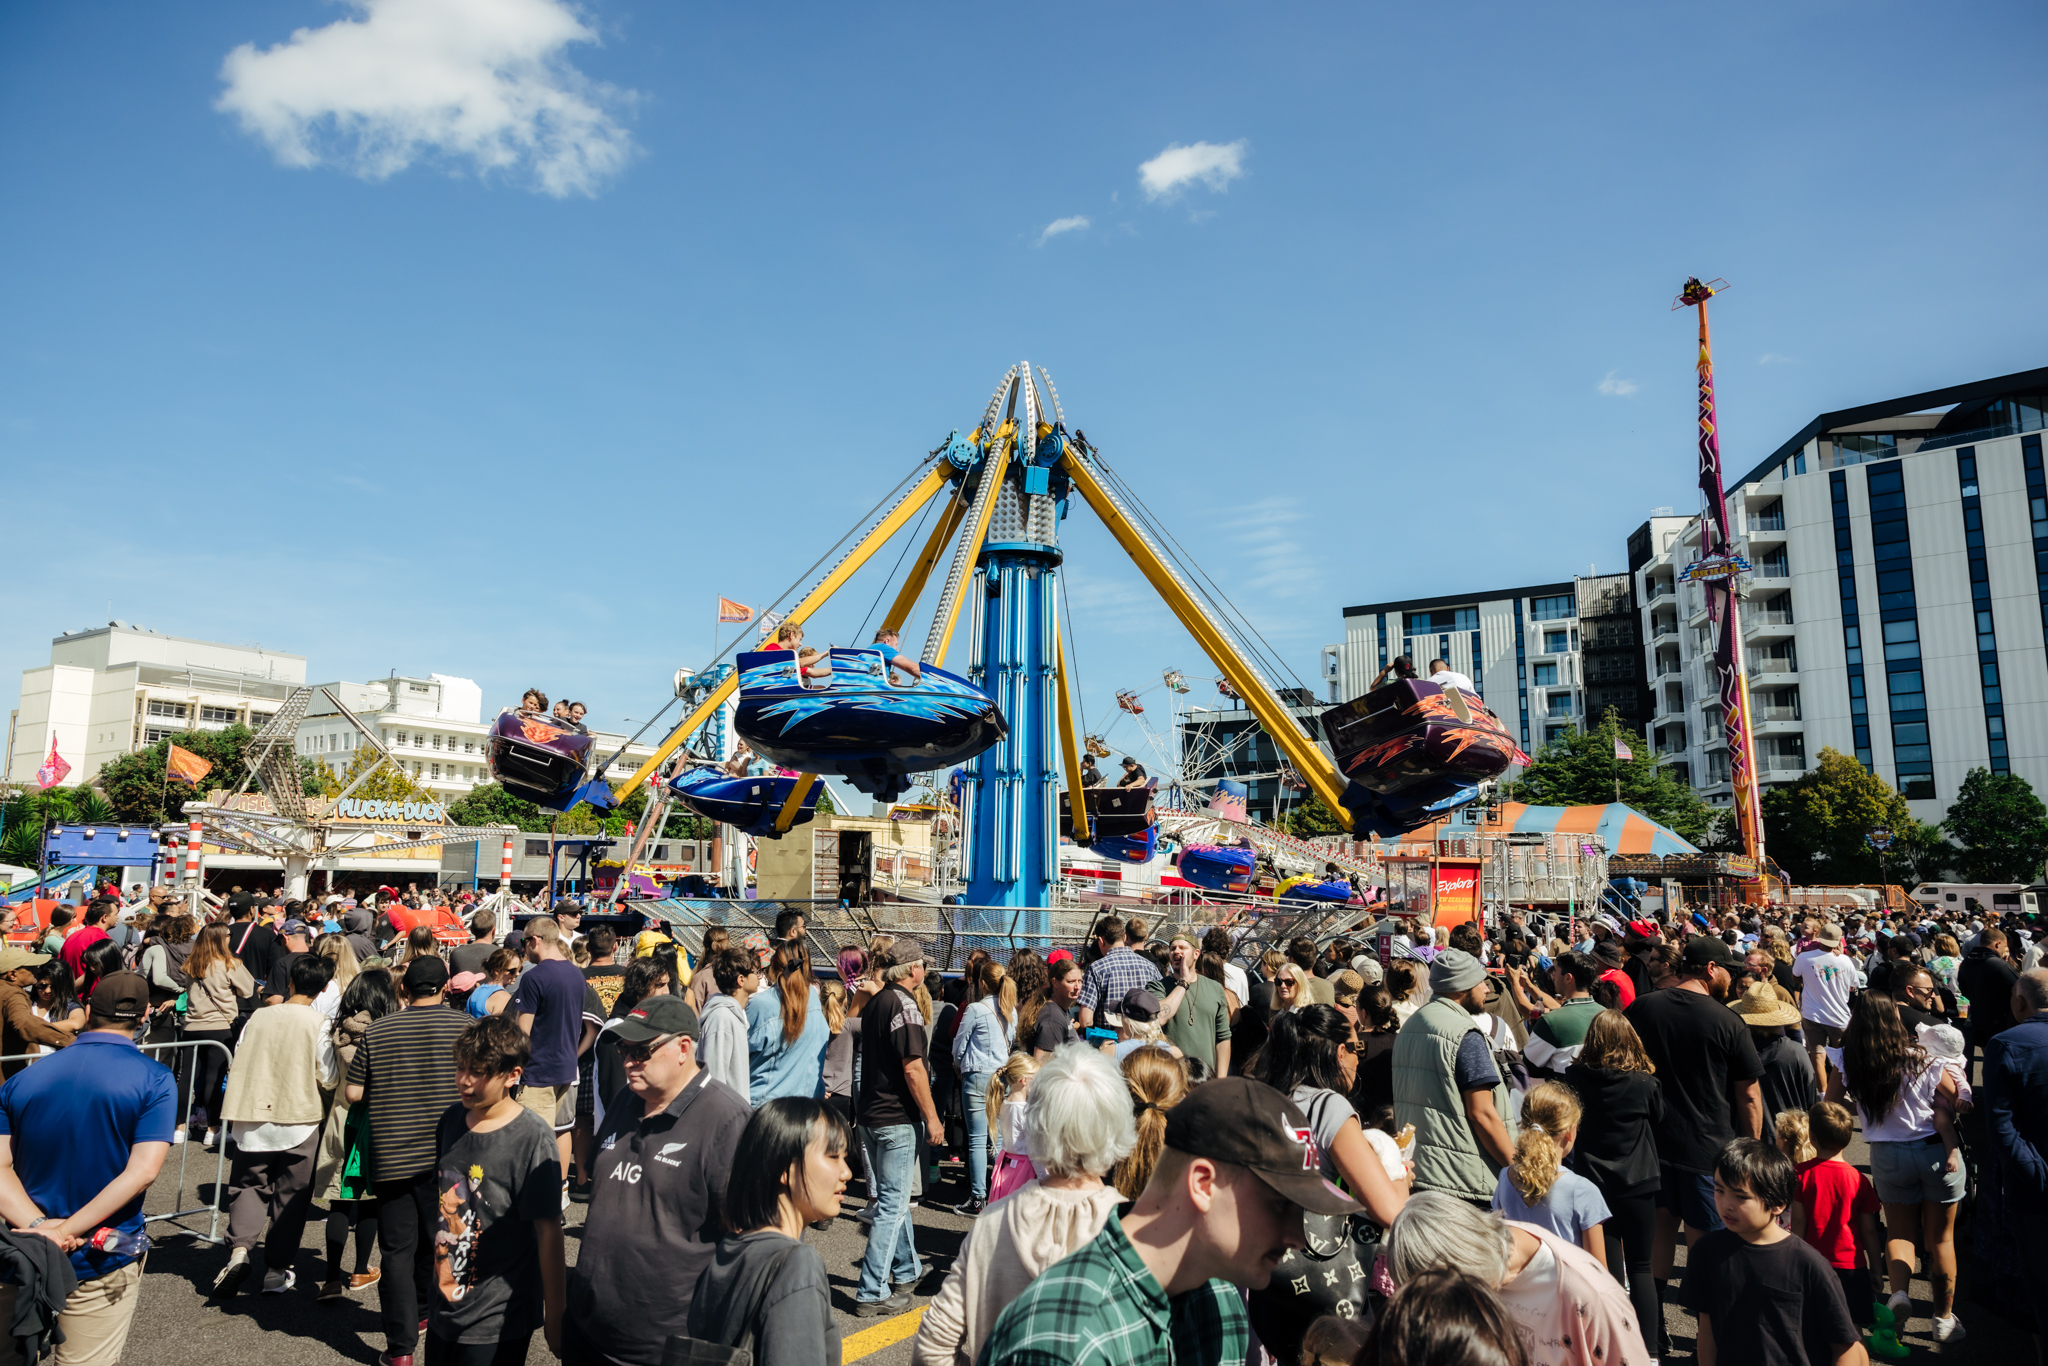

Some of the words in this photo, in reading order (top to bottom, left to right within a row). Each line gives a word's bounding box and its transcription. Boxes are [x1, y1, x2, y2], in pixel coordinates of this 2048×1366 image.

[1690, 562, 1740, 579] TURBO
[211, 789, 278, 813] Monste
[339, 798, 445, 821] PLUCK-A-DUCK
[1434, 877, 1478, 894] Explorer
[609, 1161, 642, 1184] AIG
[452, 1209, 476, 1300] NARUTO
